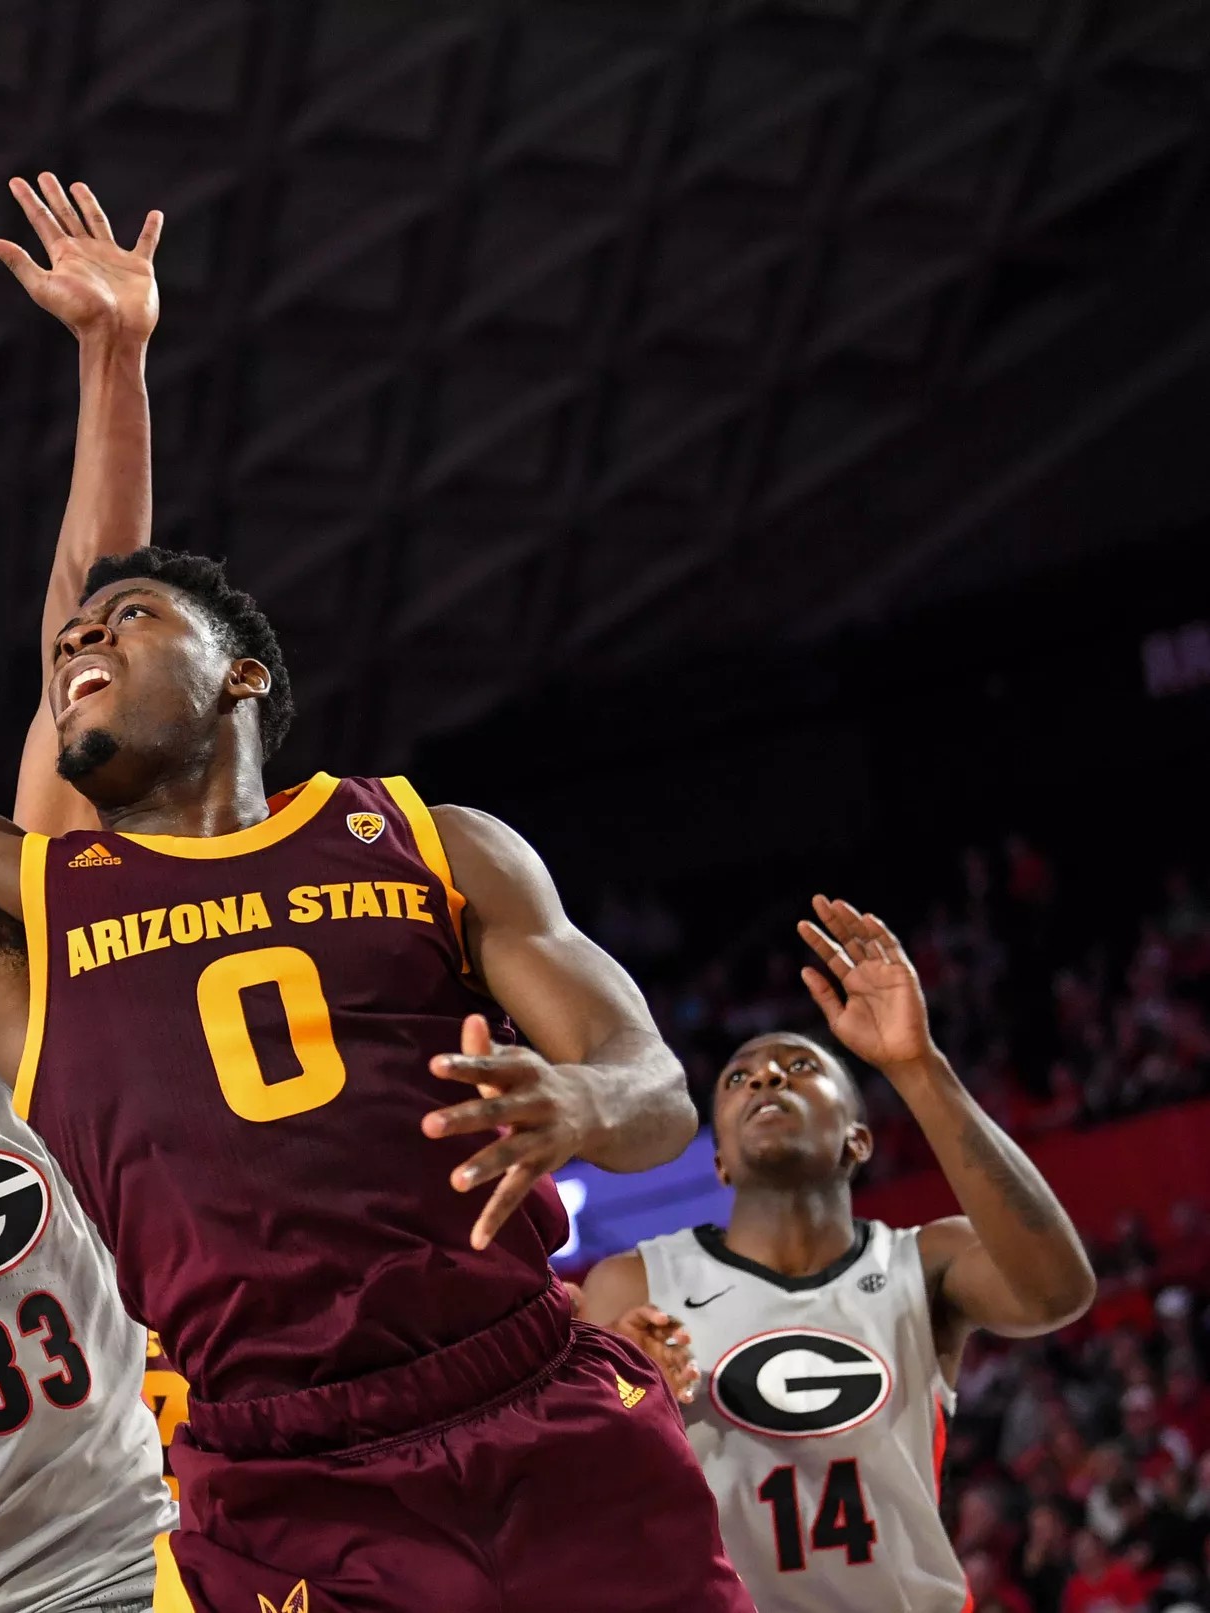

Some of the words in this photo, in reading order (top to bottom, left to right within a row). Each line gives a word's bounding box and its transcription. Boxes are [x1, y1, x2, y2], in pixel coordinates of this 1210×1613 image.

[350, 814, 382, 832] PAC
[358, 825, 377, 838] 12
[68, 857, 122, 868] adidas
[66, 892, 272, 978] ARIZONA
[288, 881, 434, 924] STATE
[197, 946, 346, 1122] 0
[858, 1274, 886, 1293] SEC
[716, 1333, 884, 1432] G
[758, 1458, 876, 1572] 14
